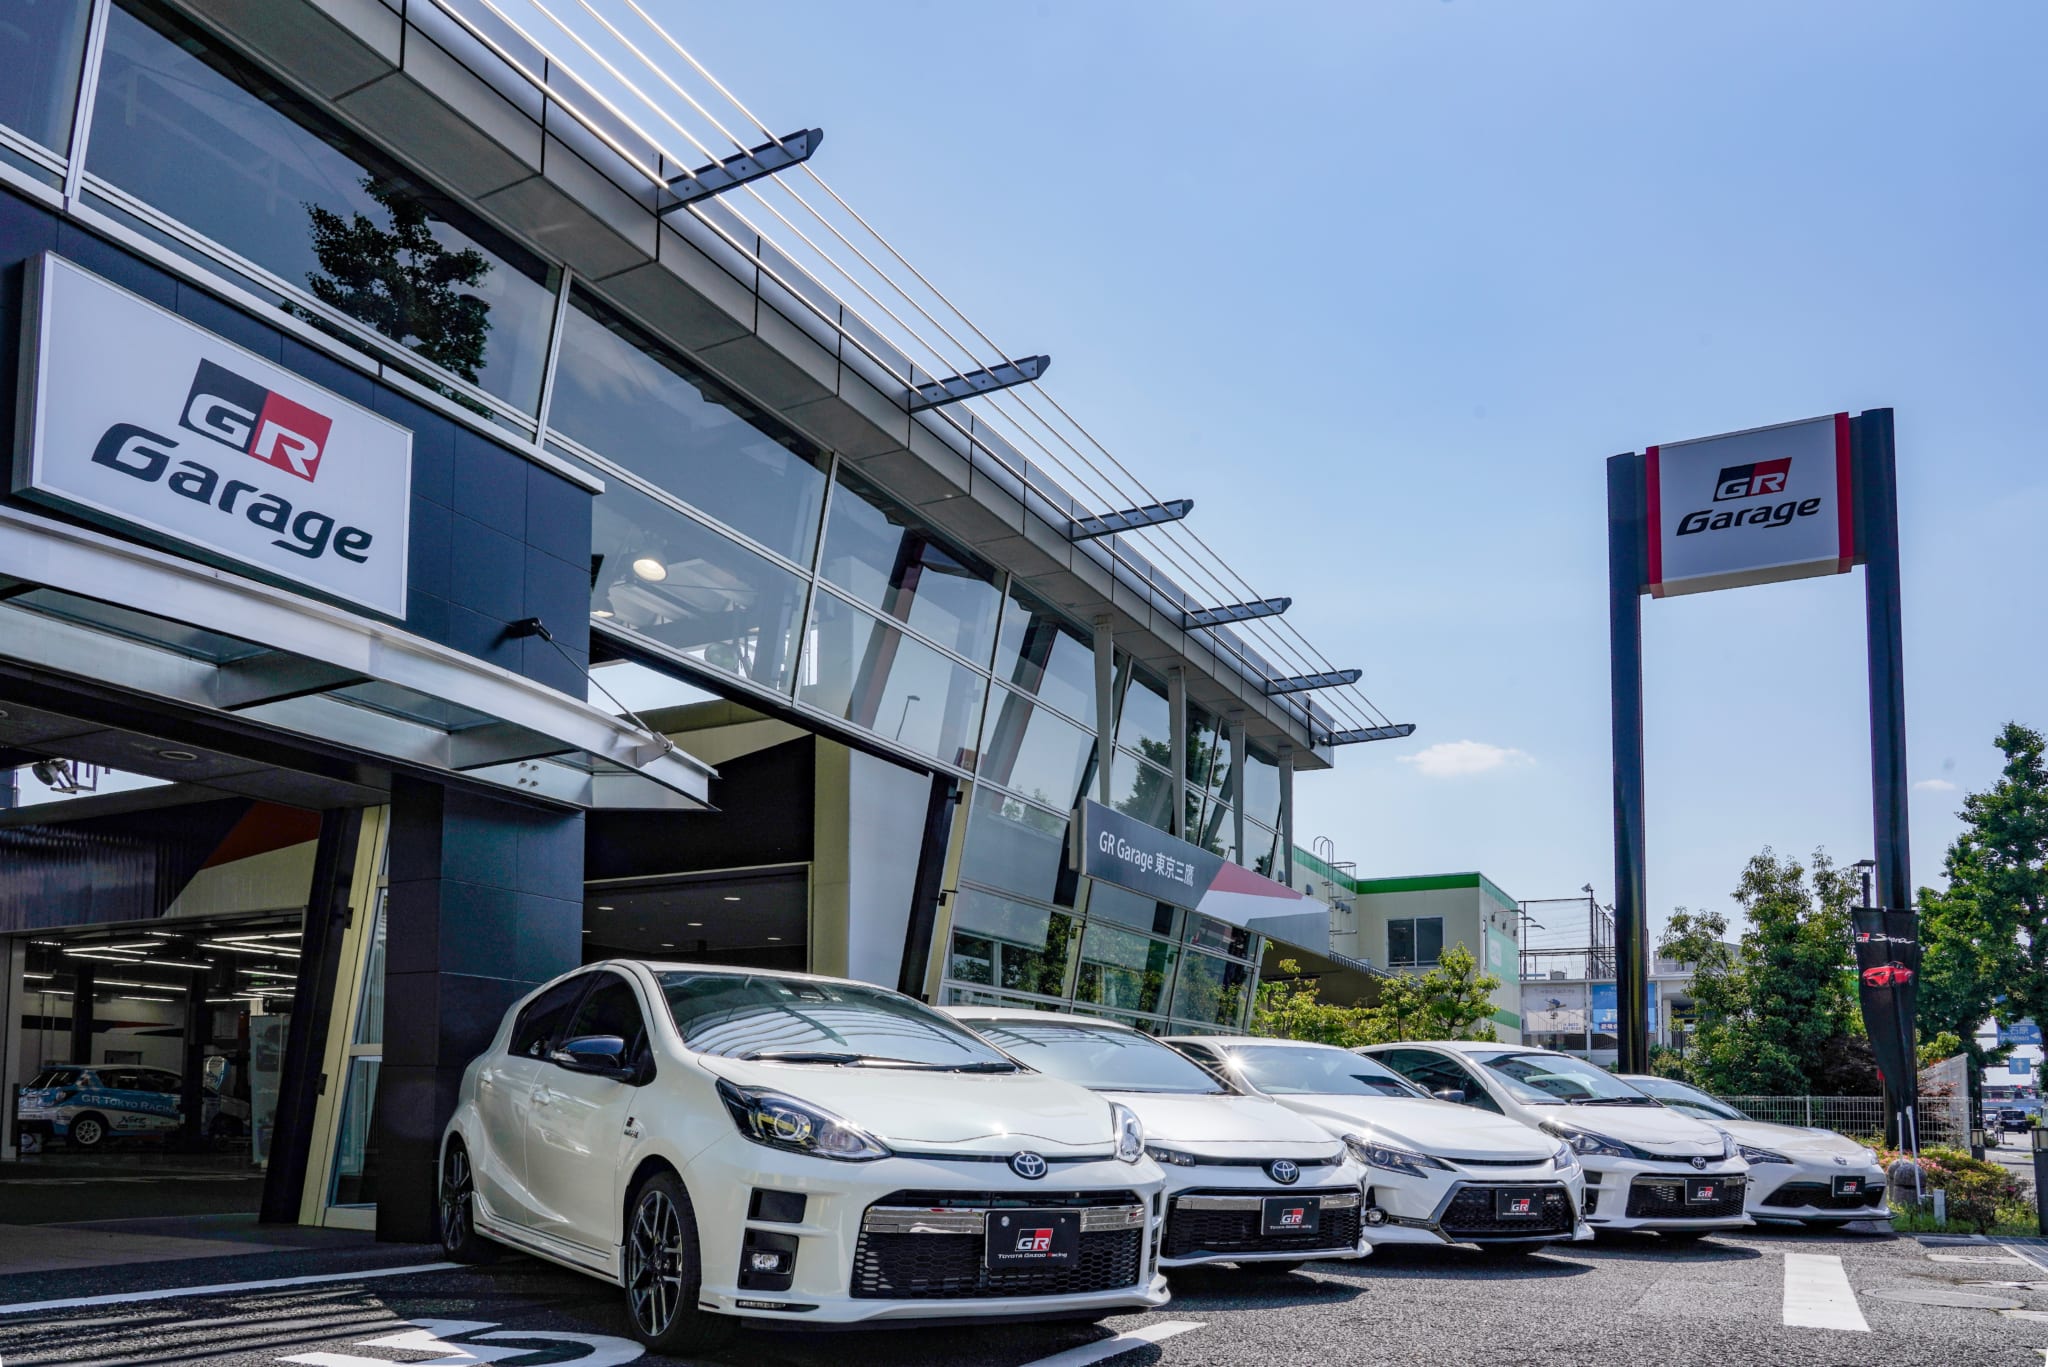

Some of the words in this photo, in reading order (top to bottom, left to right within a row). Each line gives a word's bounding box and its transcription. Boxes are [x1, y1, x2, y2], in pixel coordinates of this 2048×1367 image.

[185, 392, 320, 478] GR
[91, 422, 374, 563] Garage
[1715, 471, 1787, 499] GR
[1676, 497, 1821, 536] Garage
[1099, 831, 1115, 856] GR
[1116, 838, 1153, 873] Garage
[1154, 852, 1195, 887] 東京三鷹
[81, 1094, 100, 1104] GR
[102, 1096, 138, 1109] TOKYO
[1282, 1214, 1302, 1223] GR
[1511, 1203, 1528, 1211] GR
[1017, 1237, 1050, 1250] GR
